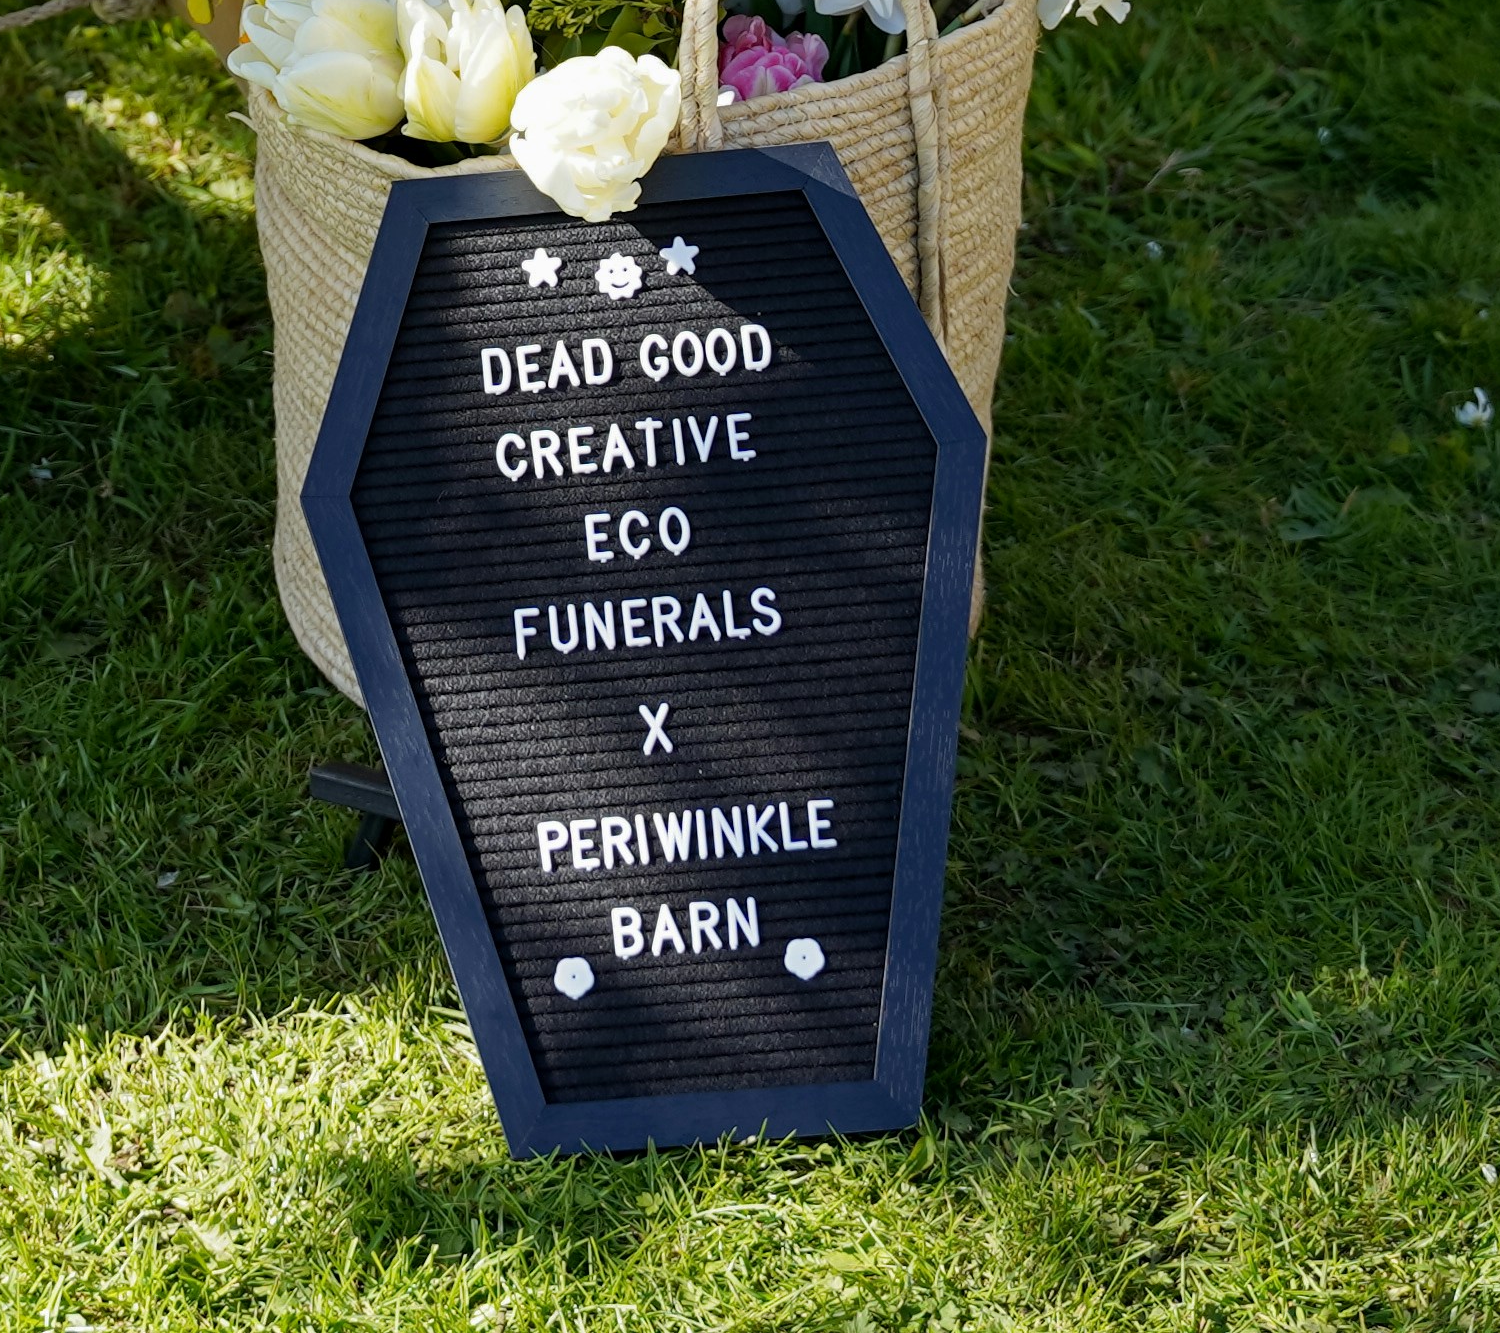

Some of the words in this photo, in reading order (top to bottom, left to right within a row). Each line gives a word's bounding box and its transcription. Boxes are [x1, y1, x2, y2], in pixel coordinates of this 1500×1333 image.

[480, 336, 613, 396] DEAD
[639, 323, 773, 382] GOOD
[494, 411, 758, 482] CREATIVE
[583, 505, 692, 564] ECO
[512, 586, 783, 661] FUNERALS
[637, 701, 674, 757] X
[535, 798, 838, 874] PERIWINKLE
[609, 895, 761, 961] BARN
